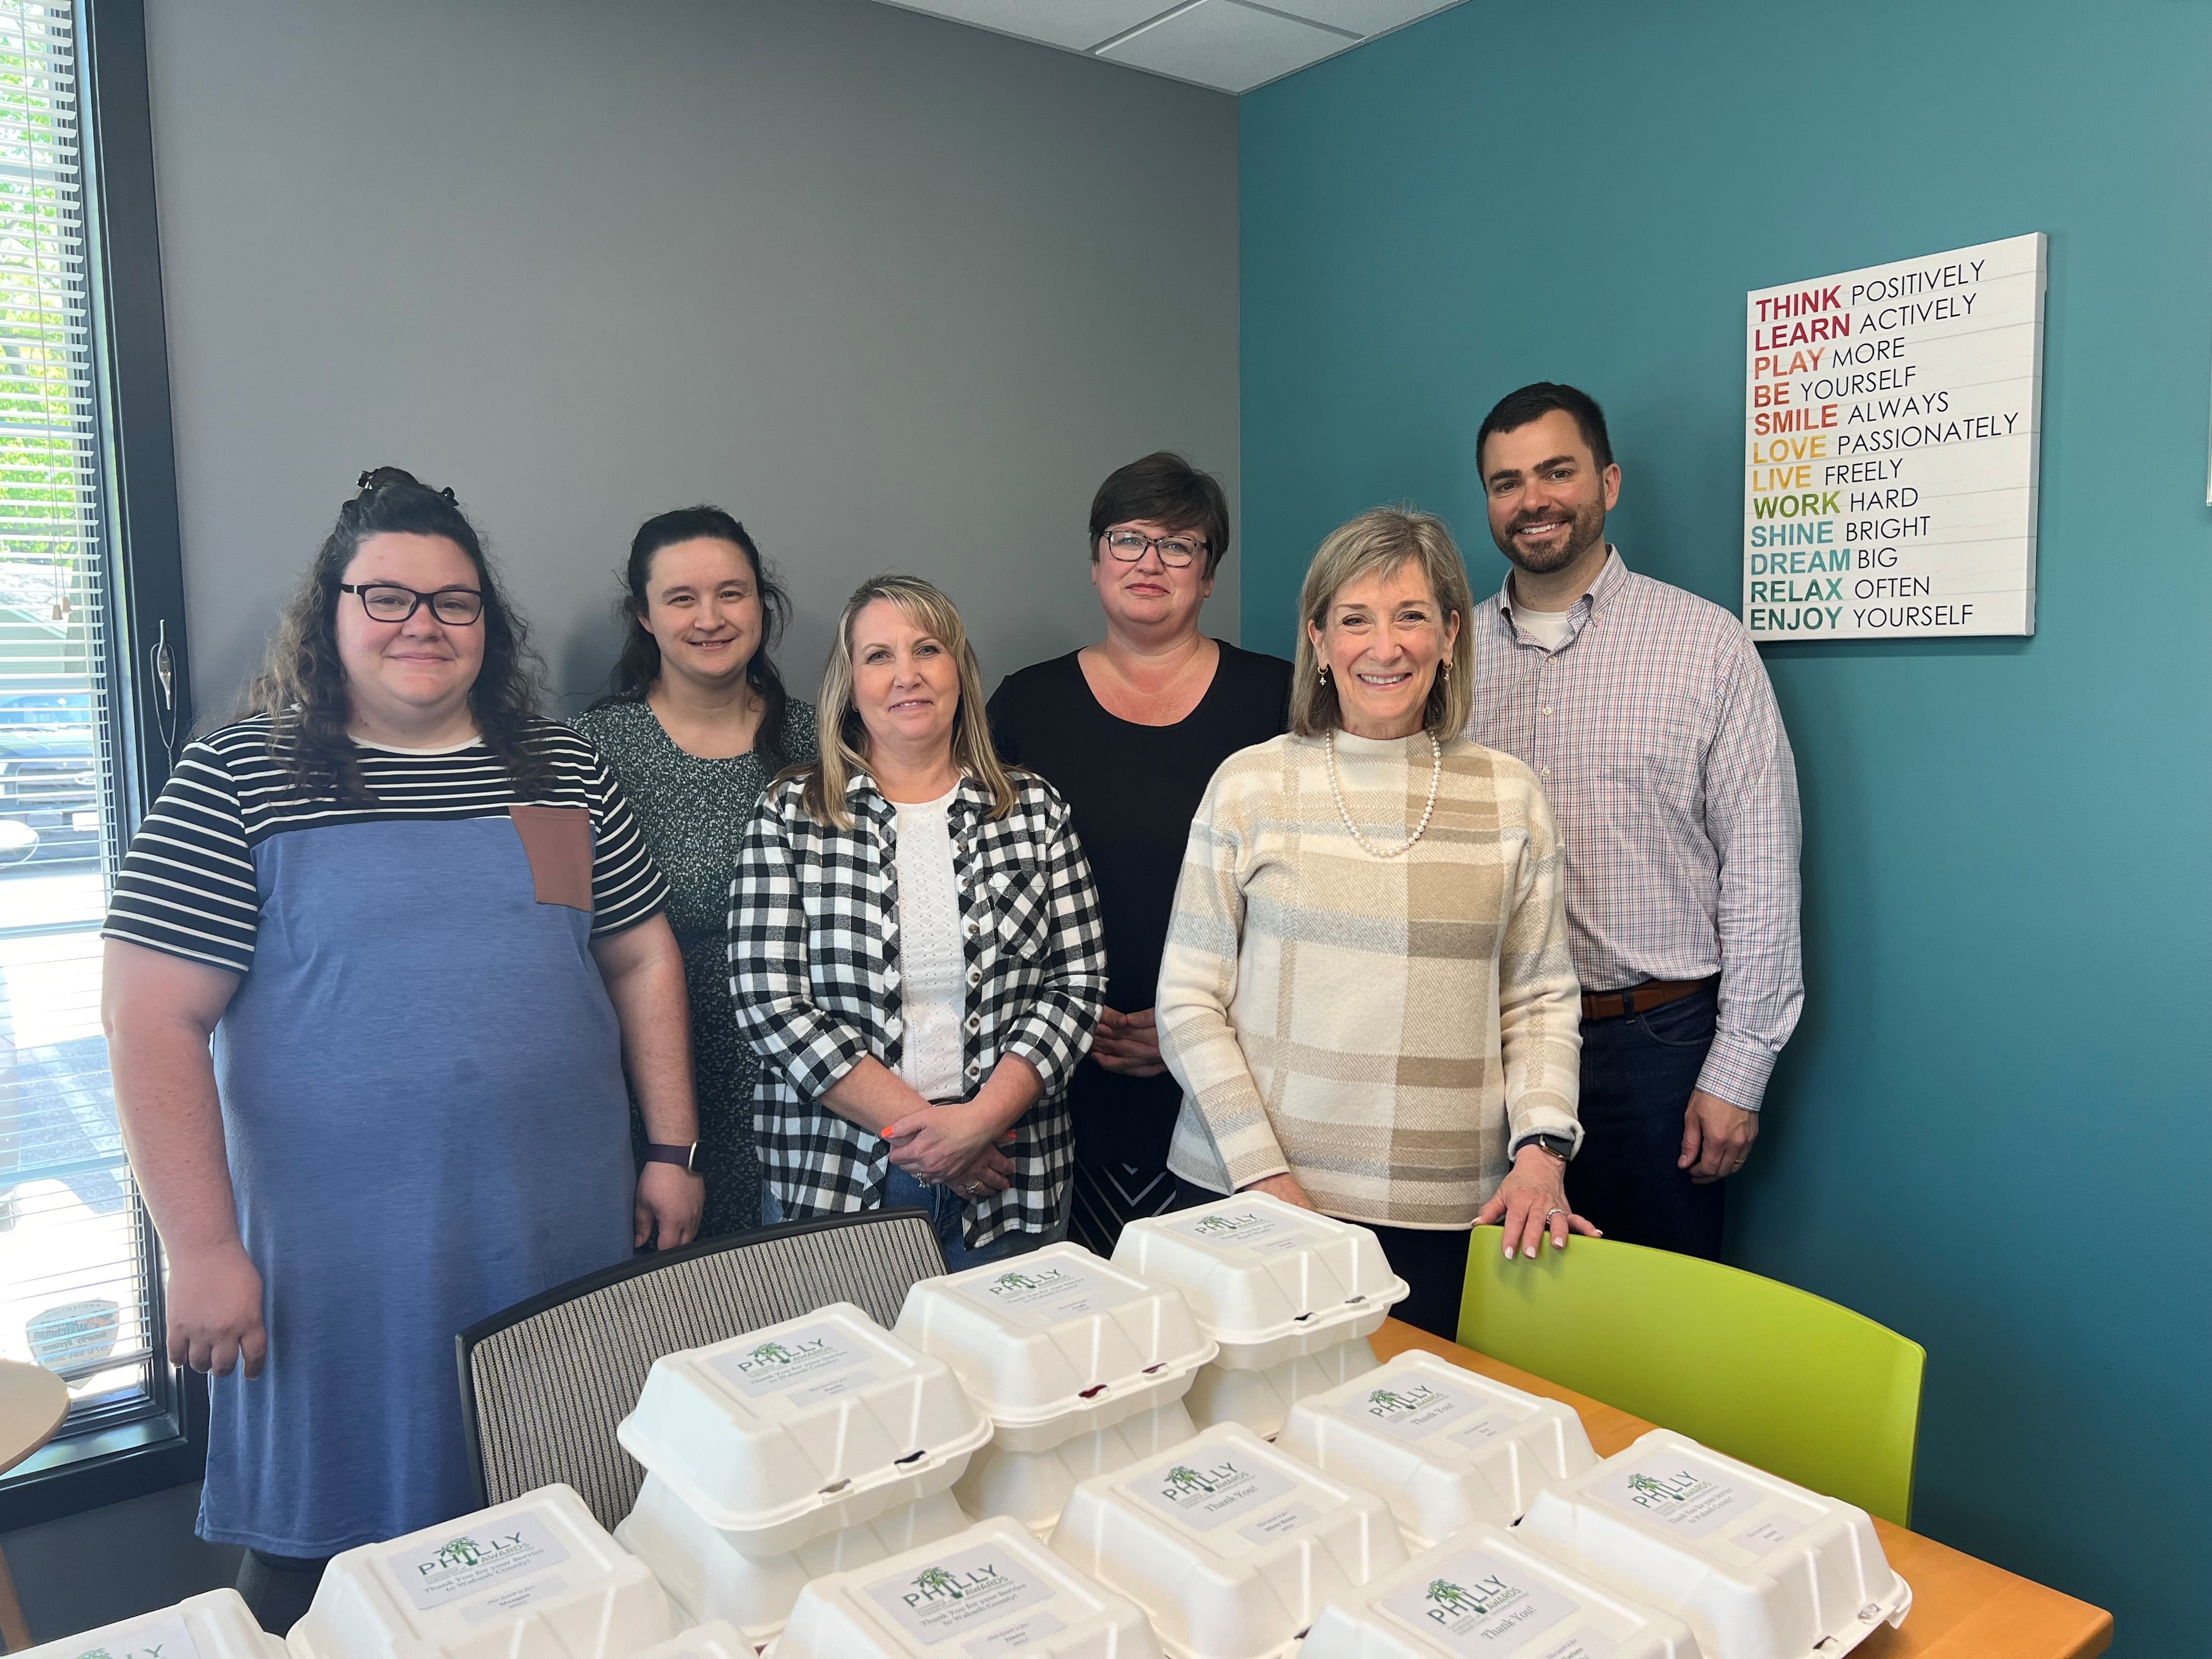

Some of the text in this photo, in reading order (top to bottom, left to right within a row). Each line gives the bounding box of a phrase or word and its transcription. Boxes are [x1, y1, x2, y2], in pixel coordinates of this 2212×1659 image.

[1757, 259, 1985, 322] THINK POSITIVELY
[1756, 293, 1977, 351] LEARN ACTIVELY
[1755, 337, 1905, 380] PLAY MORE
[1754, 366, 1916, 408] BE YOURSELF
[1755, 391, 1948, 436] SMILE ALWAYS
[1754, 413, 2019, 464] LOVE PASSIONATELY
[1753, 458, 1903, 492] LIVE FREELY
[1754, 487, 1918, 520] WORK HARD
[1751, 516, 1931, 548] SHINE BRIGHT
[1751, 548, 1898, 575] DREAM BIG
[1751, 577, 1930, 602] RELAX OFTEN
[1751, 605, 1974, 630] ENJOY YOURSELF
[1194, 1214, 1257, 1234] PHILLY
[989, 1269, 1060, 1295] PHILLY
[737, 1338, 824, 1372] PHILLY
[1368, 1385, 1432, 1417] PHILLY
[1410, 1412, 1436, 1425] Thank
[1434, 1403, 1455, 1414] You!
[1162, 1462, 1238, 1501] PHILLY
[1215, 1471, 1249, 1489] AWARDS
[1631, 1470, 1699, 1508] PHILLY
[1682, 1481, 1712, 1498] AWARDS
[1204, 1496, 1234, 1511] Thank
[1233, 1485, 1259, 1498] You!
[417, 1532, 521, 1576] PHILLY
[481, 1542, 529, 1562] AWARDS
[424, 1580, 453, 1593] Thank
[455, 1573, 473, 1582] You
[490, 1560, 510, 1570] your
[513, 1549, 544, 1562] Service
[902, 1564, 998, 1607] PHILLY
[965, 1576, 1008, 1595] AWARDS
[921, 1612, 948, 1626] Thank
[949, 1606, 965, 1615] You
[979, 1594, 997, 1604] your
[997, 1583, 1026, 1596] Service
[1426, 1575, 1507, 1625] PHILLY
[1485, 1587, 1521, 1610] AWARDS
[1481, 1620, 1515, 1639] Thank
[1510, 1605, 1537, 1621] You!
